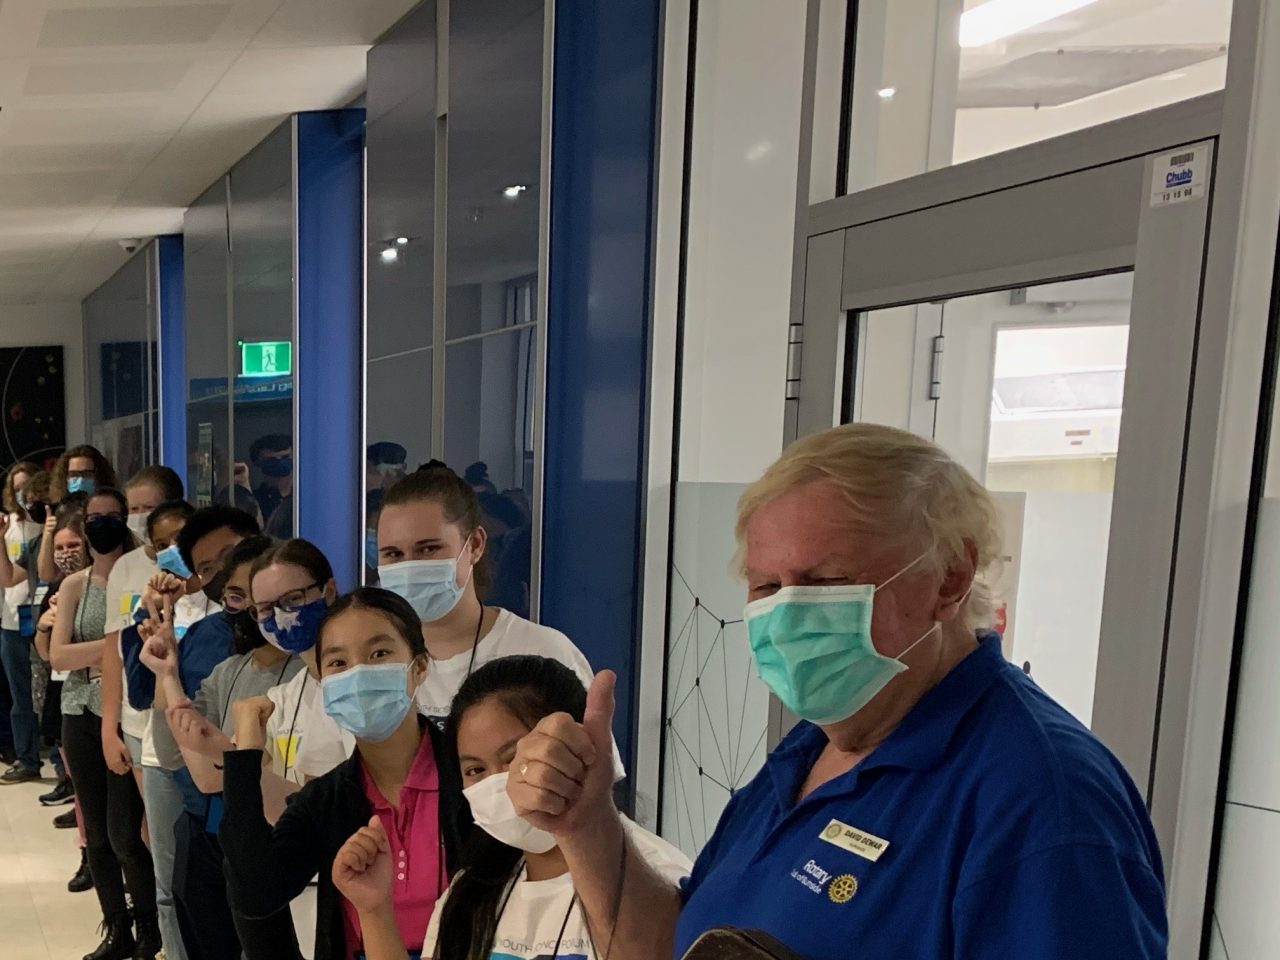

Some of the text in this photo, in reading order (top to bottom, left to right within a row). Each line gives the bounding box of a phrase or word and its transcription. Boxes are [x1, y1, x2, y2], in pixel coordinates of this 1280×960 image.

[1166, 168, 1193, 183] Chubb
[844, 830, 862, 842] DAVID
[860, 837, 883, 850] DEWAR
[803, 860, 832, 885] Rotary
